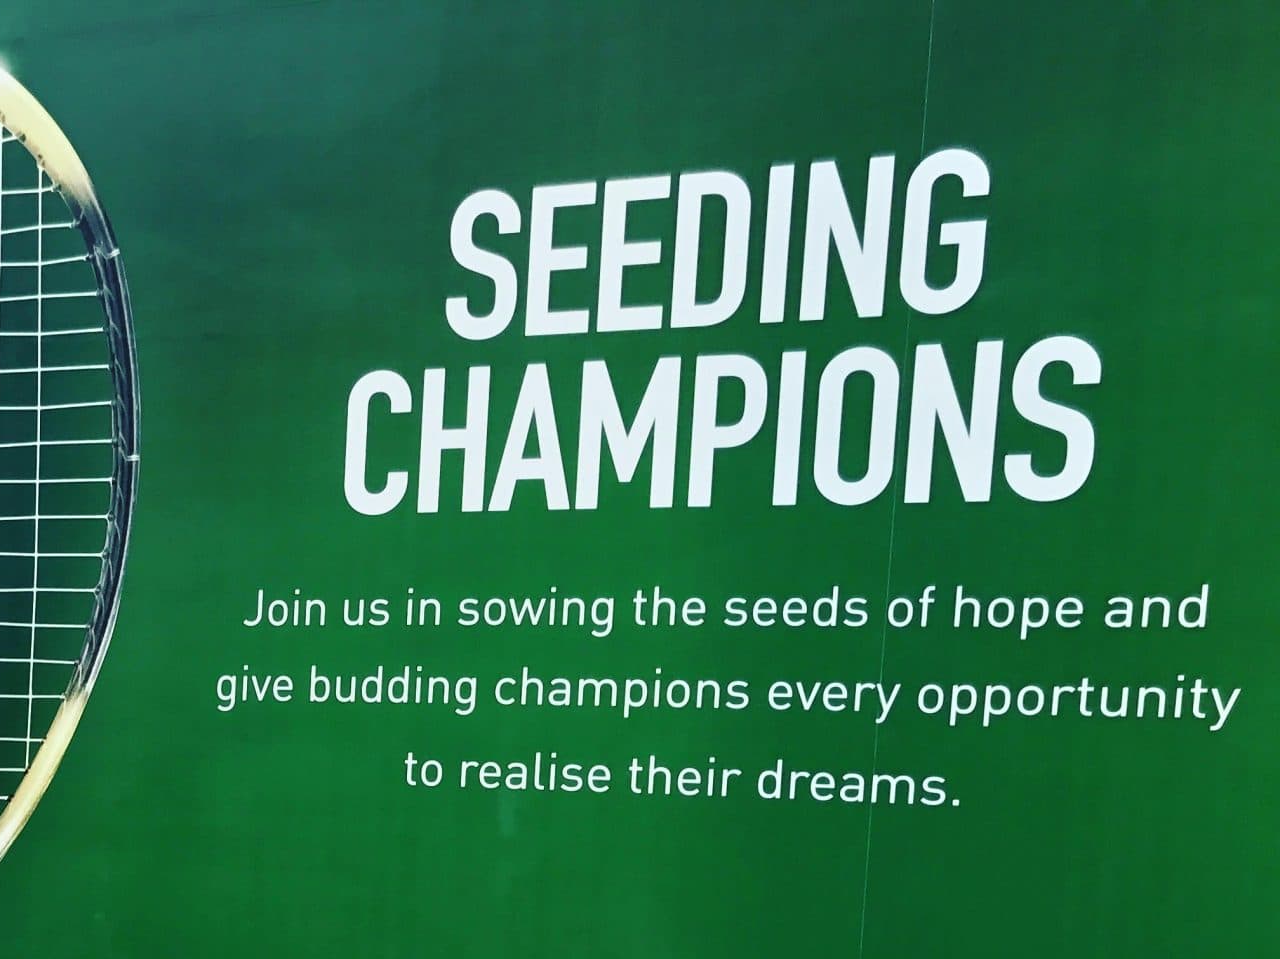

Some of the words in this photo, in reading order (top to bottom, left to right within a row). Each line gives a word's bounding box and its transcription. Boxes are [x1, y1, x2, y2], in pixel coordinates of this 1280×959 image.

[445, 148, 991, 341] SEEDING
[343, 335, 1102, 516] CHAMPIONS
[243, 588, 326, 627] Join
[343, 598, 390, 626] us
[406, 587, 441, 626] in
[457, 586, 615, 638] sowing
[632, 585, 706, 626] the
[723, 585, 868, 627] seeds
[887, 585, 936, 628] of
[953, 585, 1084, 640] hope
[1104, 583, 1209, 628] and
[216, 664, 294, 712] give
[309, 665, 477, 716] budding
[494, 666, 749, 718] champions
[768, 681, 901, 724] every
[917, 674, 1242, 731] opportunity
[404, 752, 443, 787] to
[460, 751, 611, 793] realise
[628, 755, 742, 797] their
[757, 759, 960, 807] dreams.
